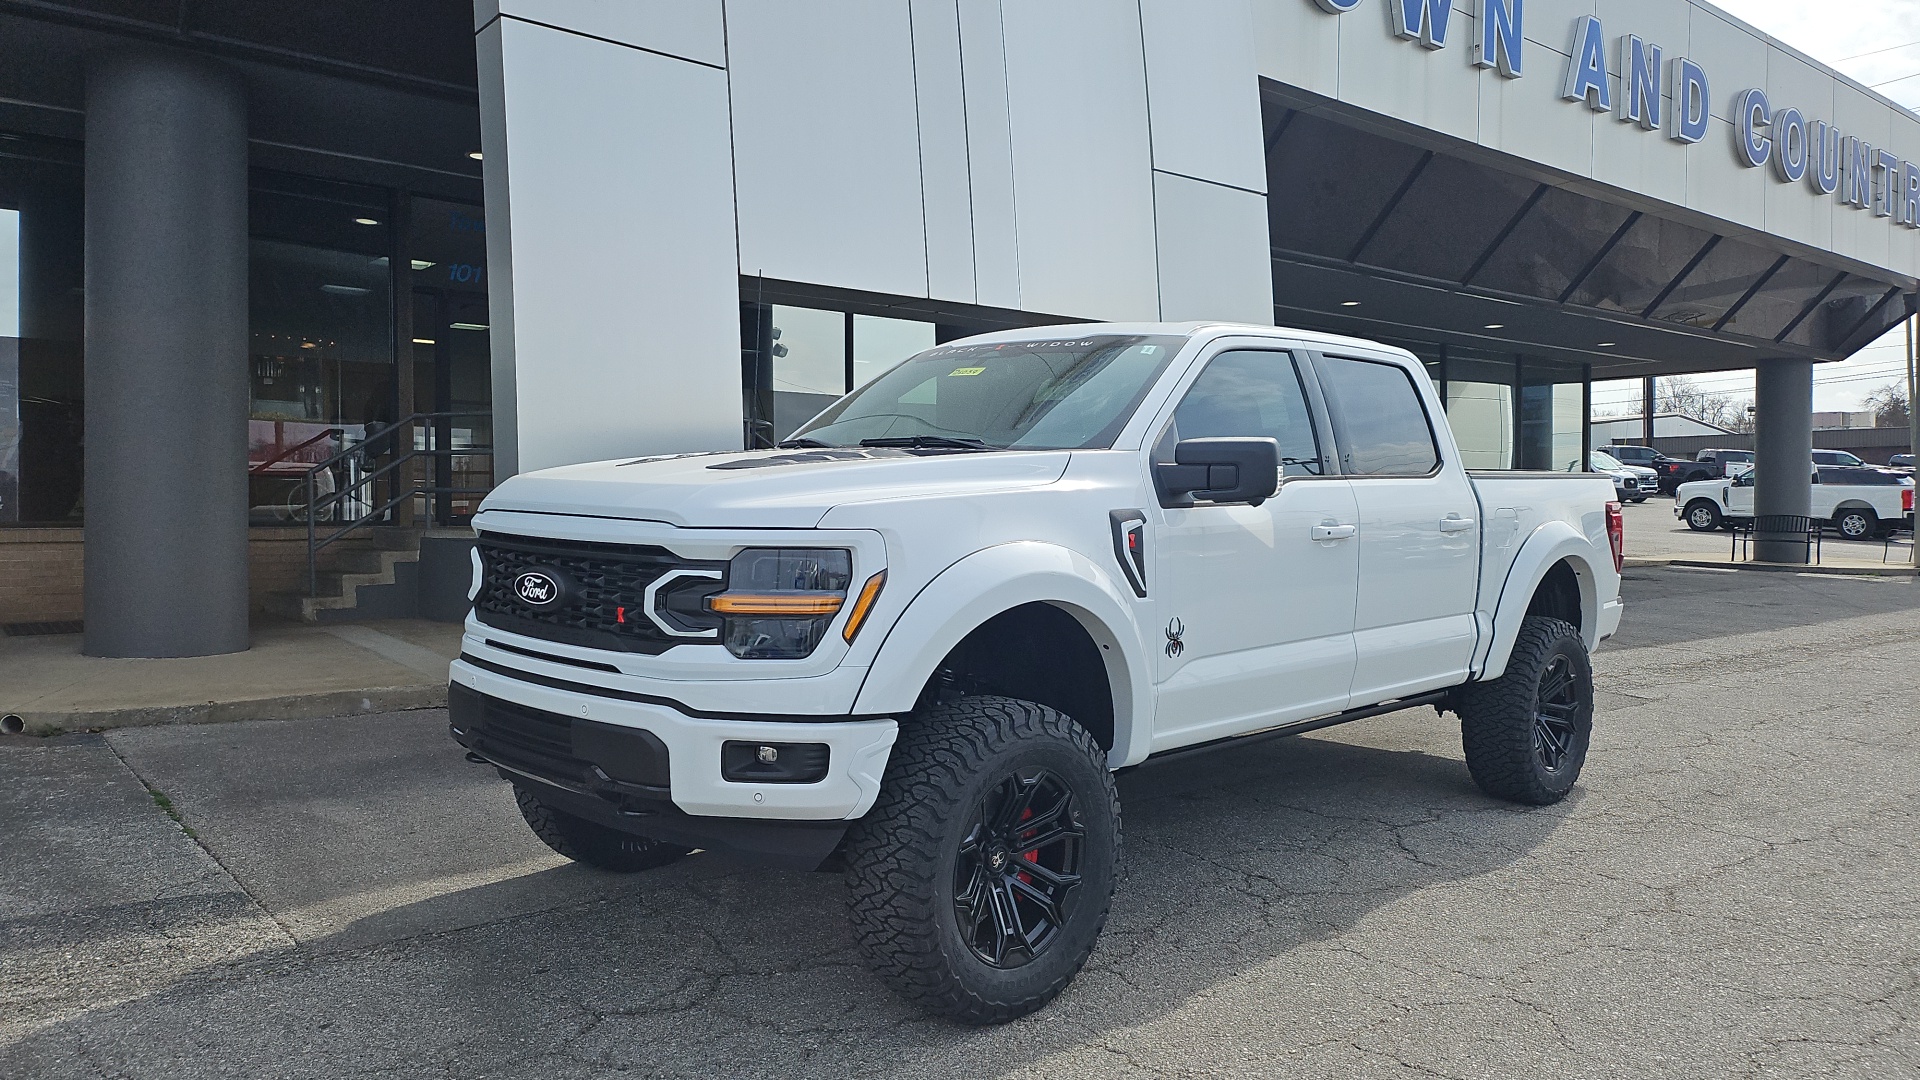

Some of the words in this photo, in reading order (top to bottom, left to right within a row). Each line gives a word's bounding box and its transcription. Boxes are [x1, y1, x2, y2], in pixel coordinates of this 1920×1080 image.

[1314, 0, 1523, 79] WN
[1562, 14, 1711, 144] AND
[1734, 87, 1920, 228] COUNTR
[448, 263, 482, 283] 101
[1026, 340, 1094, 348] WIDOW
[521, 576, 549, 600] Ford
